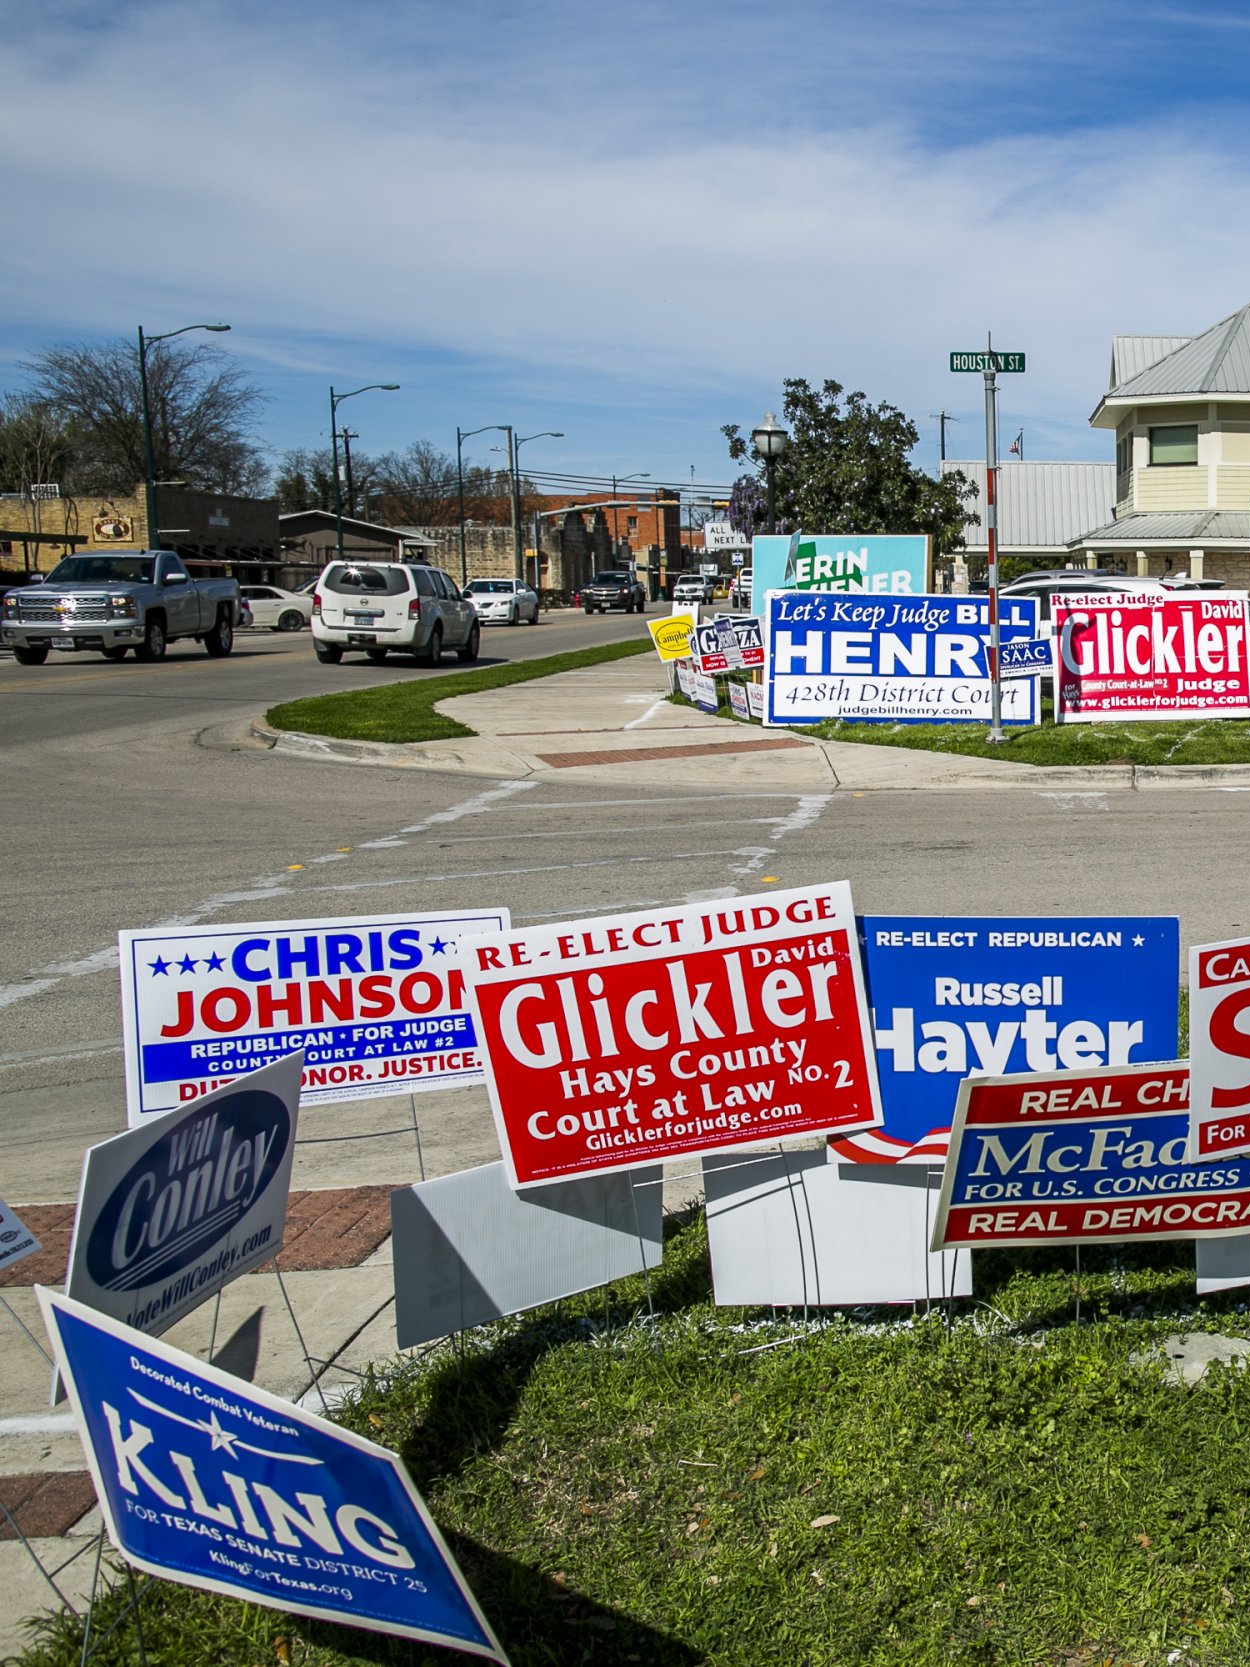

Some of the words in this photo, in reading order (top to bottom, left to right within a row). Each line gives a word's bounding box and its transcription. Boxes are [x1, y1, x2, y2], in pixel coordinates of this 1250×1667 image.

[953, 355, 1005, 370] HOUSTON
[1008, 355, 1023, 370] ST.
[710, 526, 726, 535] ALL
[714, 536, 735, 544] NEXT
[796, 547, 869, 583] ERIN
[778, 597, 827, 621] Let's
[831, 602, 886, 630] Keep
[885, 604, 950, 632] Judge
[1051, 594, 1113, 606] Re-elect
[1116, 593, 1164, 607] Judge
[1201, 600, 1244, 620] David
[700, 629, 761, 653] GZA
[1002, 646, 1047, 663] SAAC
[1060, 610, 1244, 676] Glickler
[786, 680, 852, 705] 428th
[859, 679, 944, 704] District
[1081, 680, 1106, 692] County
[1176, 678, 1240, 693] Judge
[838, 705, 972, 717] judgebillhenry.com
[1065, 695, 1248, 709] www.glicklerforjudge.com
[475, 918, 686, 972] RE-ELECT
[700, 896, 837, 946] JUDGE
[876, 931, 978, 947] RE-ELECT
[988, 931, 1122, 947] REPUBLICAN
[231, 928, 423, 983] CHRIS
[750, 936, 834, 969] David
[935, 975, 1063, 1007] Russell
[499, 950, 840, 1070] Glickler
[190, 1031, 334, 1060] REPUBLICAN
[352, 1025, 394, 1043] FOR
[399, 1018, 467, 1037] JUDGE
[304, 1047, 356, 1061] OURT
[364, 1044, 384, 1056] AT
[392, 1039, 429, 1053] LAW
[434, 1036, 455, 1048] #2
[872, 1007, 1144, 1077] Hayter
[378, 1051, 483, 1079] JUSTICE.
[558, 1063, 657, 1100] Hays
[669, 1037, 808, 1081] County
[527, 1105, 640, 1141] Court
[651, 1090, 688, 1120] at
[703, 1078, 776, 1112] Law
[833, 1060, 855, 1090] 2
[1019, 1085, 1123, 1115] REAL
[586, 1100, 804, 1151] Glicklerforjudge.com
[1207, 1123, 1246, 1145] FOR
[168, 1112, 219, 1177] Will
[111, 1123, 279, 1270] Conley
[964, 1181, 1024, 1201] FOR
[1031, 1180, 1084, 1199] U.S.
[1094, 1168, 1240, 1196] CONGRESS
[967, 1206, 1068, 1234] REAL
[129, 1355, 192, 1396] Decorated
[192, 1385, 243, 1418] Combat
[243, 1408, 300, 1438] Veteran
[102, 1400, 416, 1570] KLING
[124, 1498, 161, 1525] FOR
[160, 1511, 224, 1543] TEXAS
[225, 1533, 302, 1567] SENATE
[303, 1555, 399, 1586] DISTRICT
[403, 1577, 428, 1595] 25
[209, 1549, 354, 1601] KlingForTexas.org
